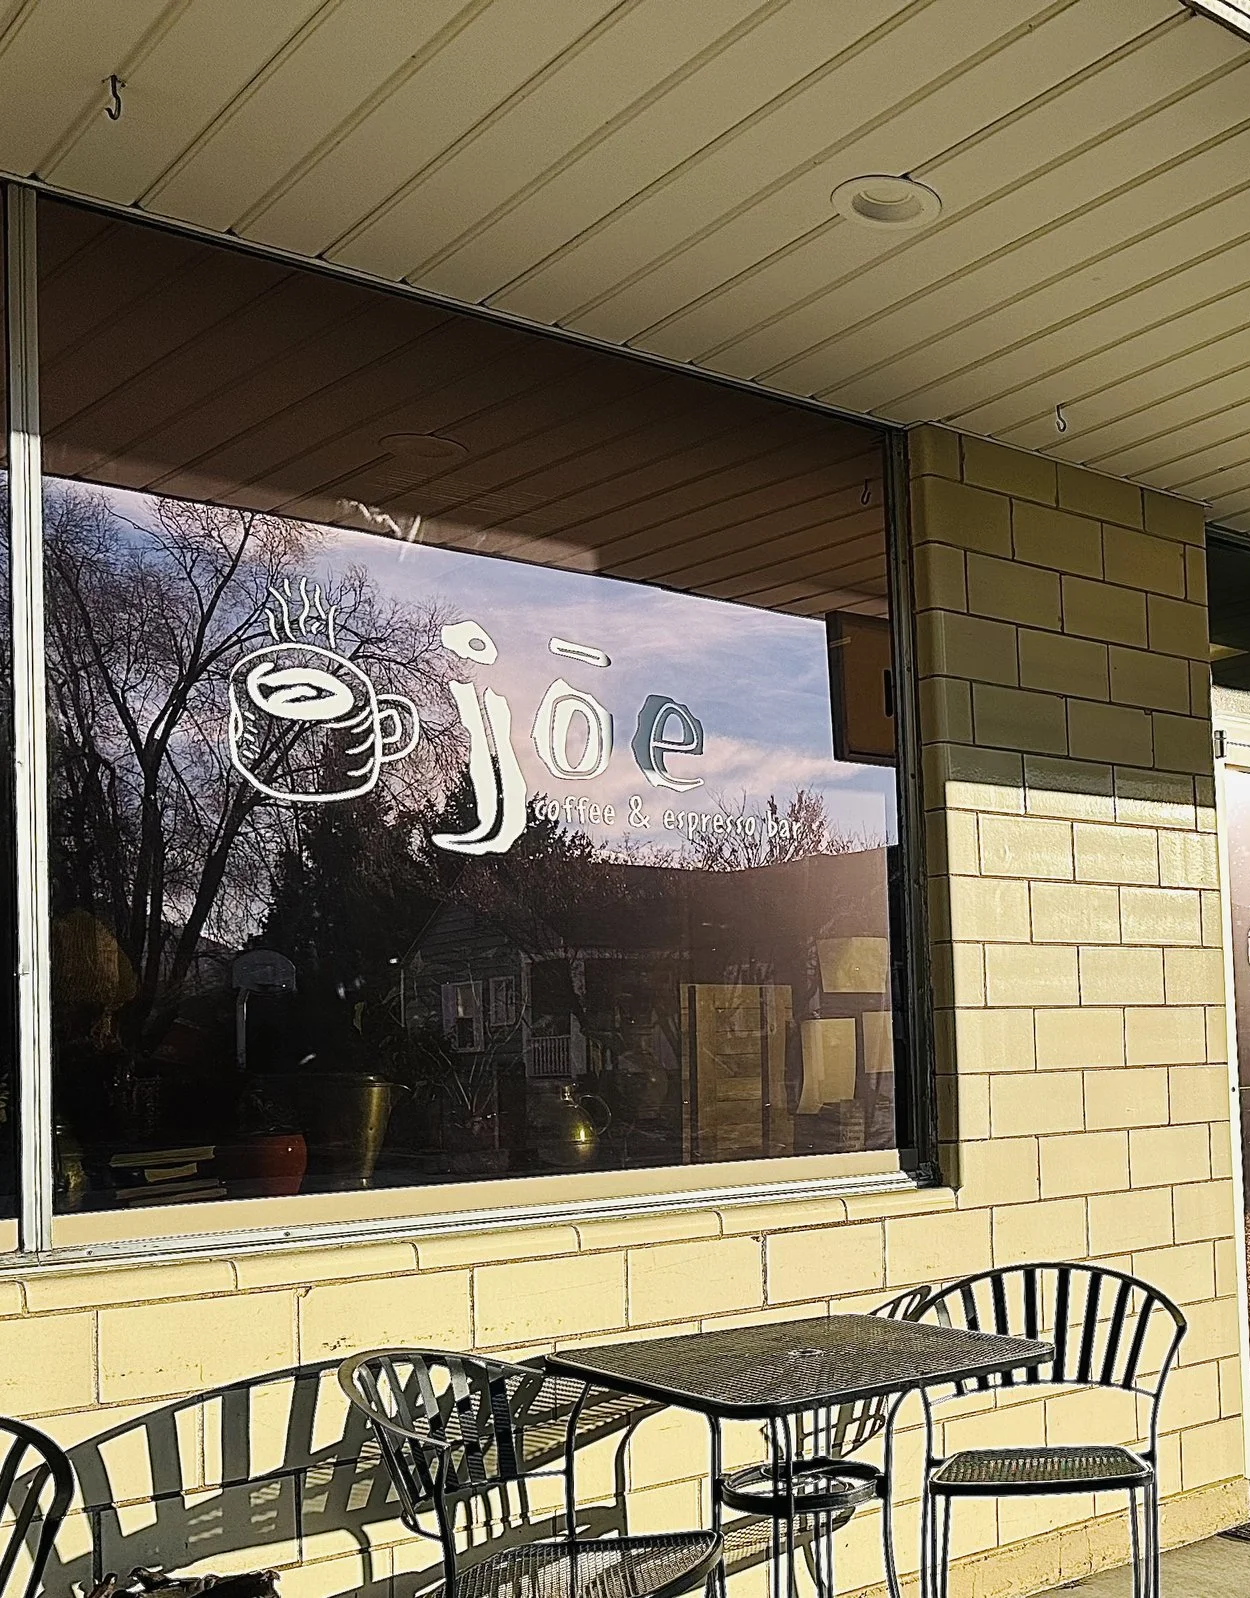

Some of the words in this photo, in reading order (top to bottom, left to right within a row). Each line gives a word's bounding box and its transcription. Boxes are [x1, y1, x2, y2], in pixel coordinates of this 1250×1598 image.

[533, 795, 616, 825] coffee
[628, 795, 651, 829] &
[662, 808, 756, 840] espresso
[766, 810, 803, 840] bar
